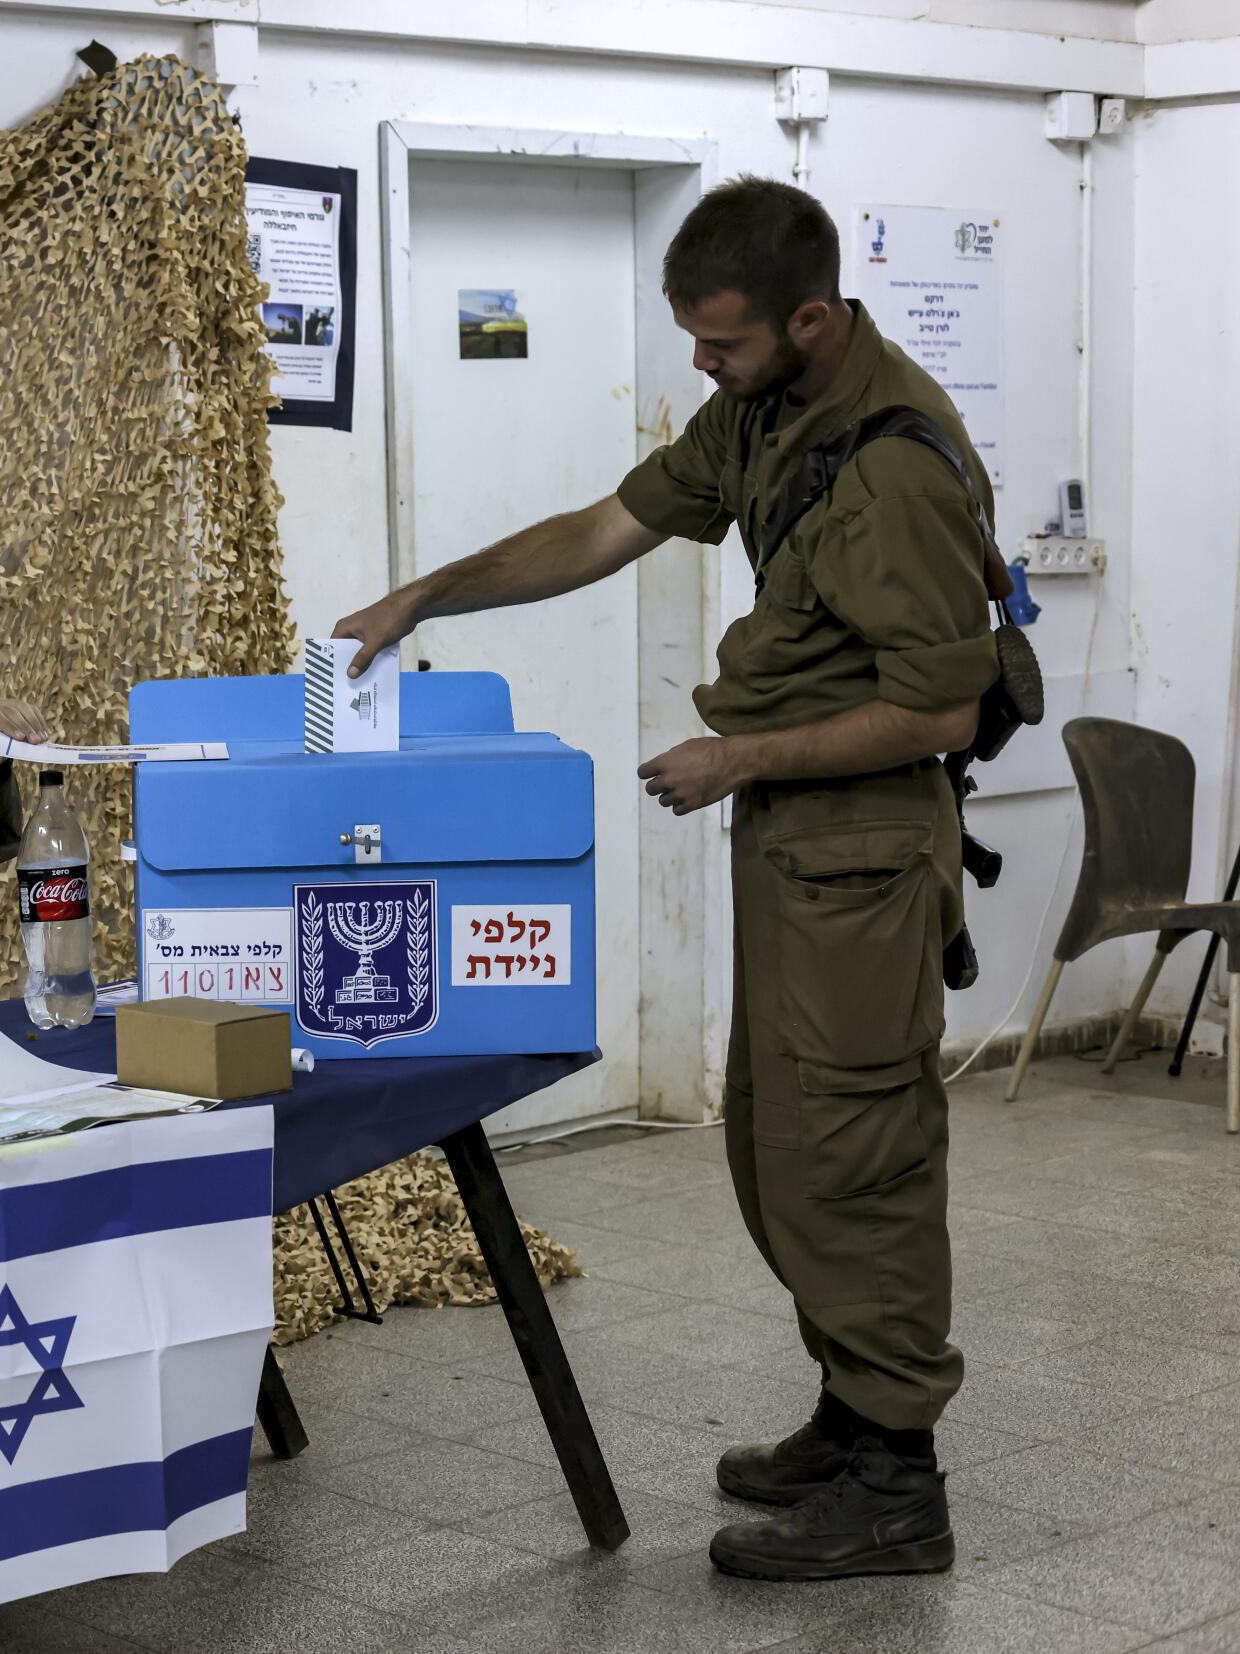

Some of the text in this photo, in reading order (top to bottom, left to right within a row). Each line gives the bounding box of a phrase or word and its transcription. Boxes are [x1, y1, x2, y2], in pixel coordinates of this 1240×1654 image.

[51, 868, 70, 876] zero
[29, 877, 89, 905] Coca-Cola
[470, 911, 551, 951] קלפי
[190, 944, 241, 957] צבאית
[246, 941, 283, 959] קלפי
[465, 953, 556, 979] ניידת
[327, 1005, 407, 1030] ישראל
